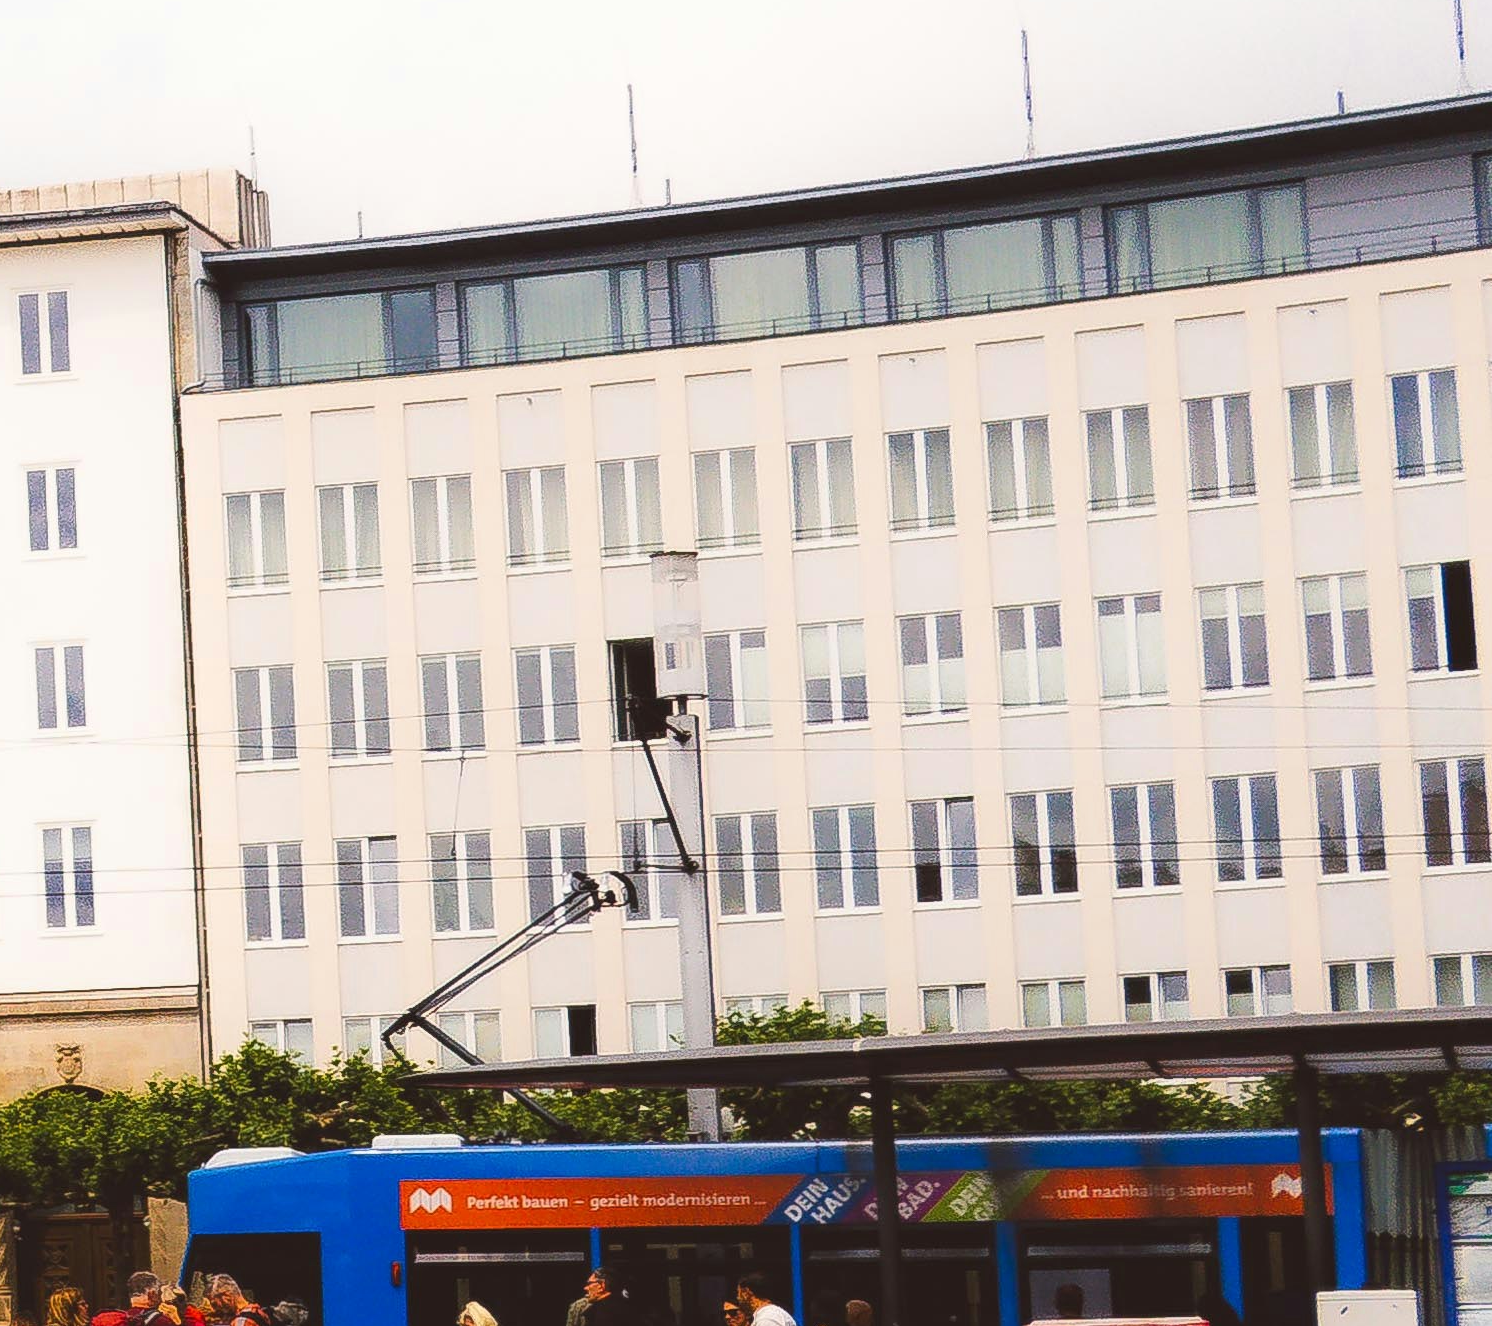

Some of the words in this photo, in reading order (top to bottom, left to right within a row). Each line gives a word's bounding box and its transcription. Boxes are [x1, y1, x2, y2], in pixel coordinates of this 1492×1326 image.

[466, 1195, 519, 1210] Perfekt
[521, 1194, 569, 1209] bauen
[589, 1193, 639, 1211] gezielt
[641, 1192, 752, 1208] modernisieren
[783, 1176, 830, 1223] DEIN
[810, 1176, 867, 1225] HAUS.
[1056, 1184, 1089, 1201] und
